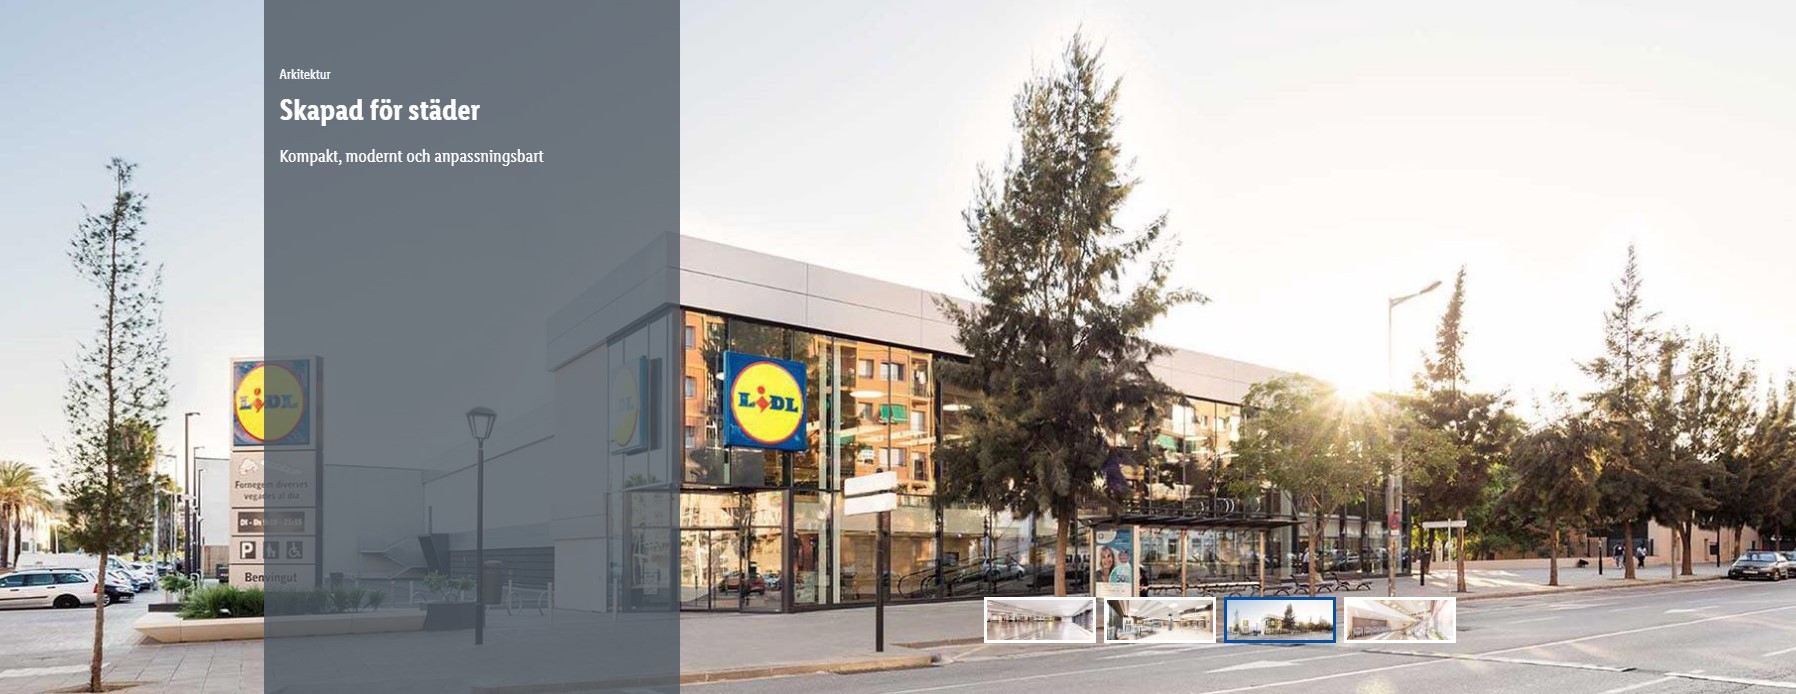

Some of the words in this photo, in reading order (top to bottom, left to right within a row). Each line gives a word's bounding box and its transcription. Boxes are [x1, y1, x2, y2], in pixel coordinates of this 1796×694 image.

[235, 481, 273, 490] Fornegem
[242, 542, 253, 558] P
[245, 572, 297, 584] Benvingut
